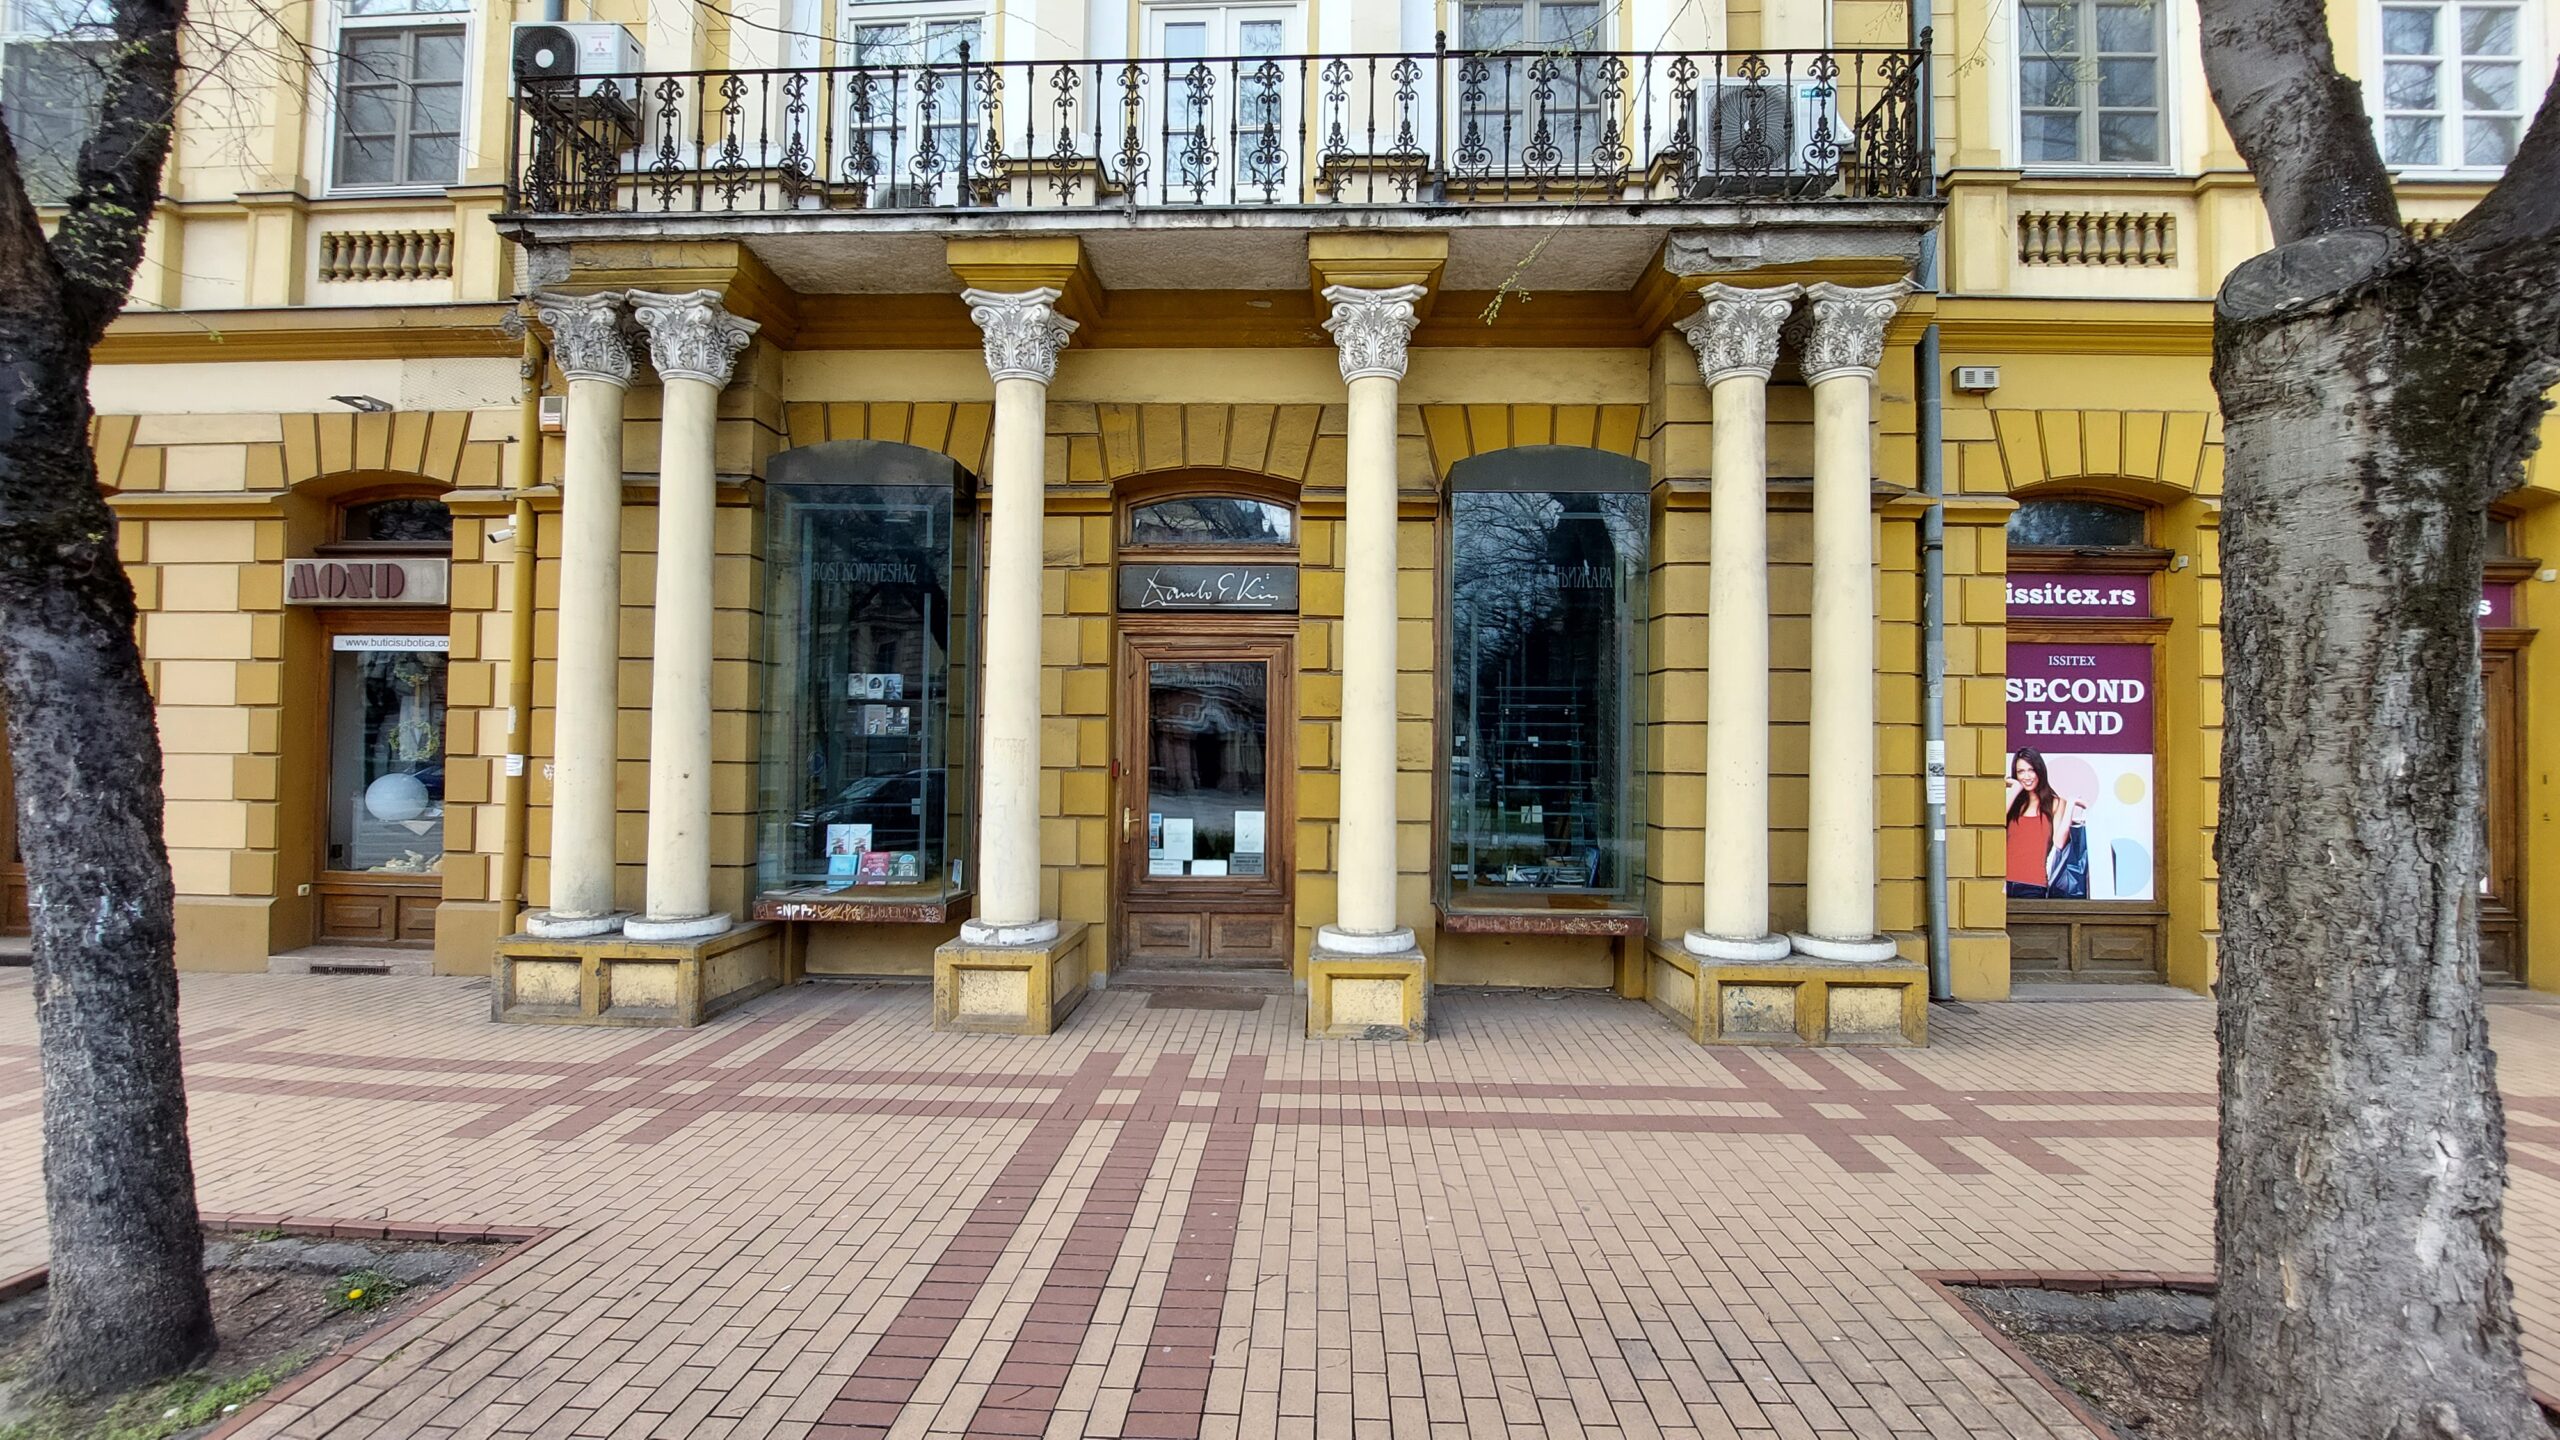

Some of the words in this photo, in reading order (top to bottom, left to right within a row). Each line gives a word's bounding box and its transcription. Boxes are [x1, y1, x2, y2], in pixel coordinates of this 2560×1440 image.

[288, 563, 405, 599] MOND
[1555, 566, 1613, 589] ЊИЖАРА
[2006, 582, 2136, 606] issitex.rs
[2048, 655, 2096, 666] ISSITEX
[2006, 678, 2145, 703] SECOND
[2025, 711, 2124, 735] HAND
